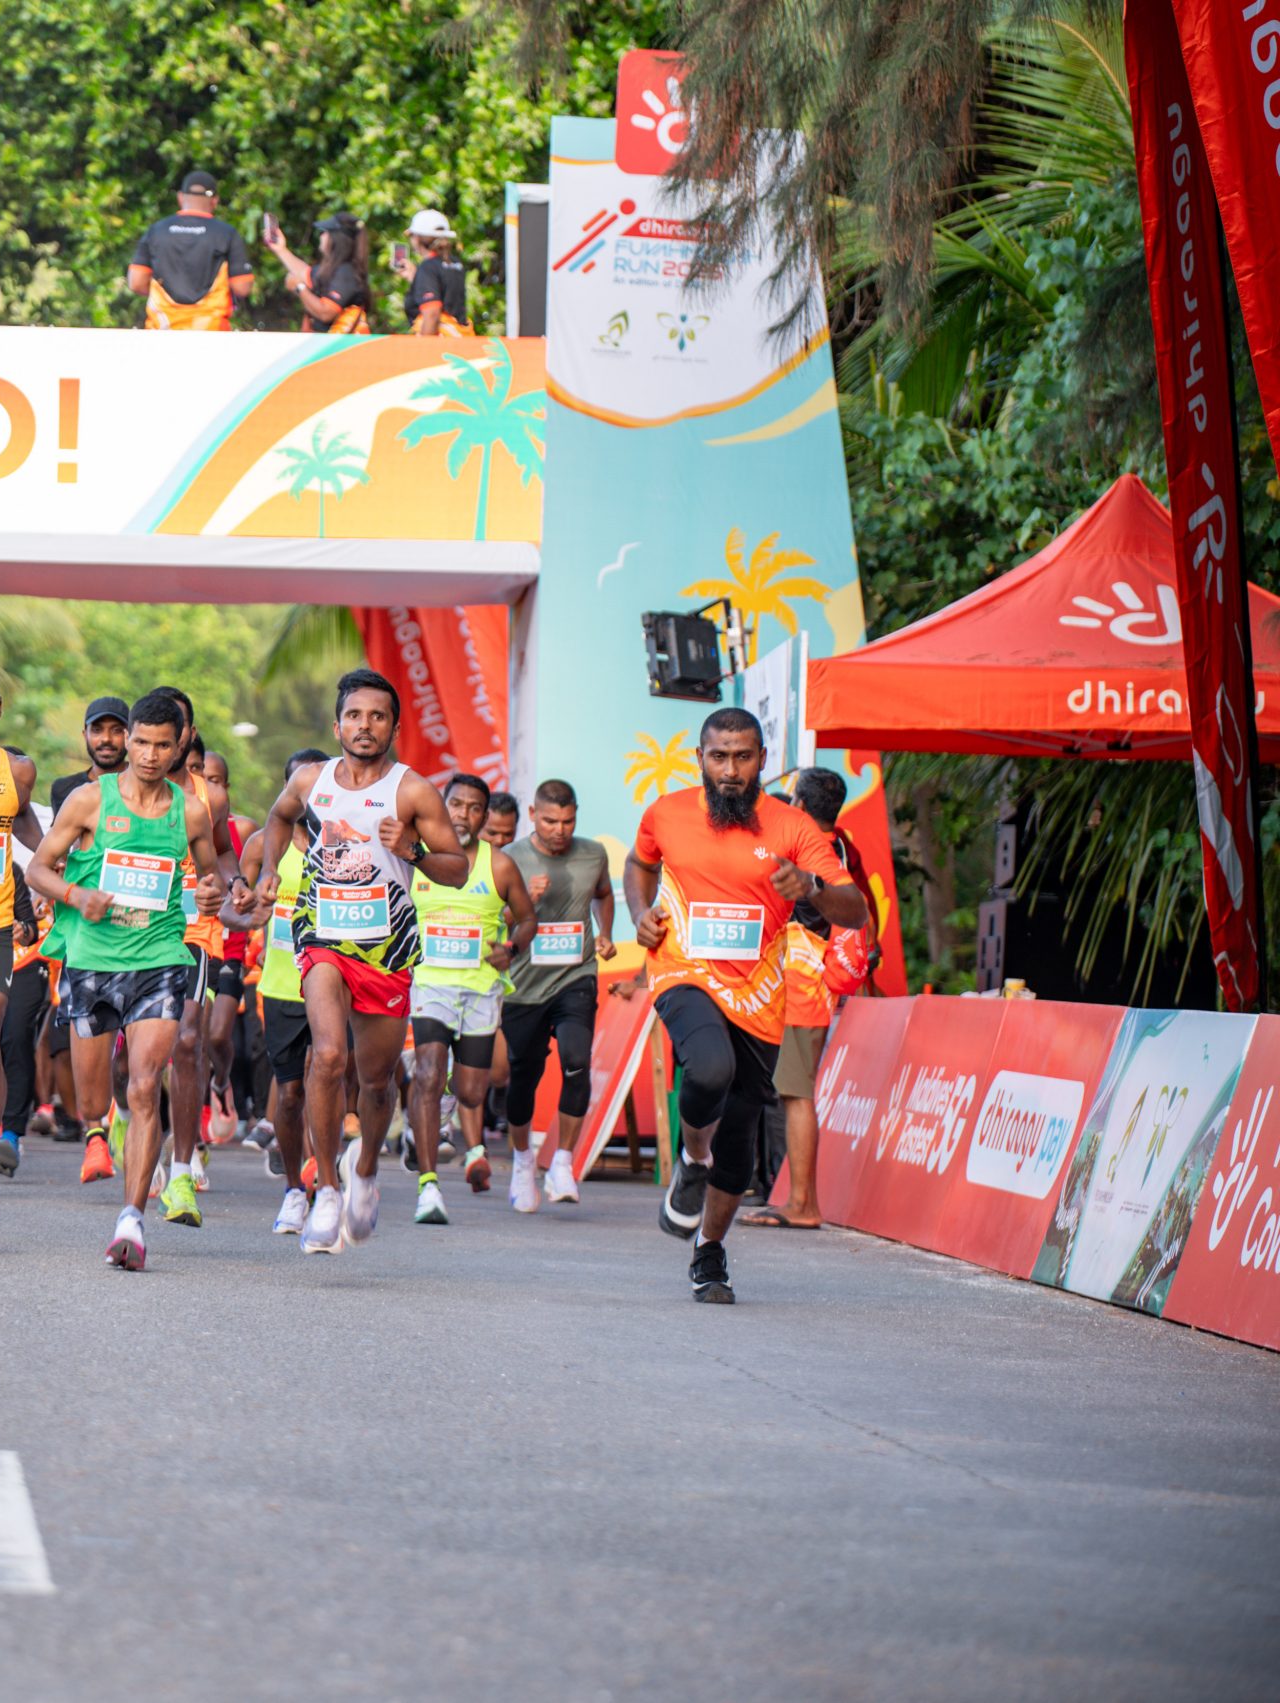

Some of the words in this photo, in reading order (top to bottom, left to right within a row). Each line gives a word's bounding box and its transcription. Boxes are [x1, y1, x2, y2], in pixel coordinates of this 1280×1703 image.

[614, 257, 660, 275] RUN
[1167, 102, 1208, 433] dhiraagu
[118, 871, 159, 891] 1853
[330, 905, 375, 920] 1760
[706, 924, 747, 941] 1351
[435, 940, 470, 954] 1299
[540, 937, 578, 950] 2203
[979, 1088, 1046, 1173] dhiraagu
[1033, 1116, 1073, 1176] pay
